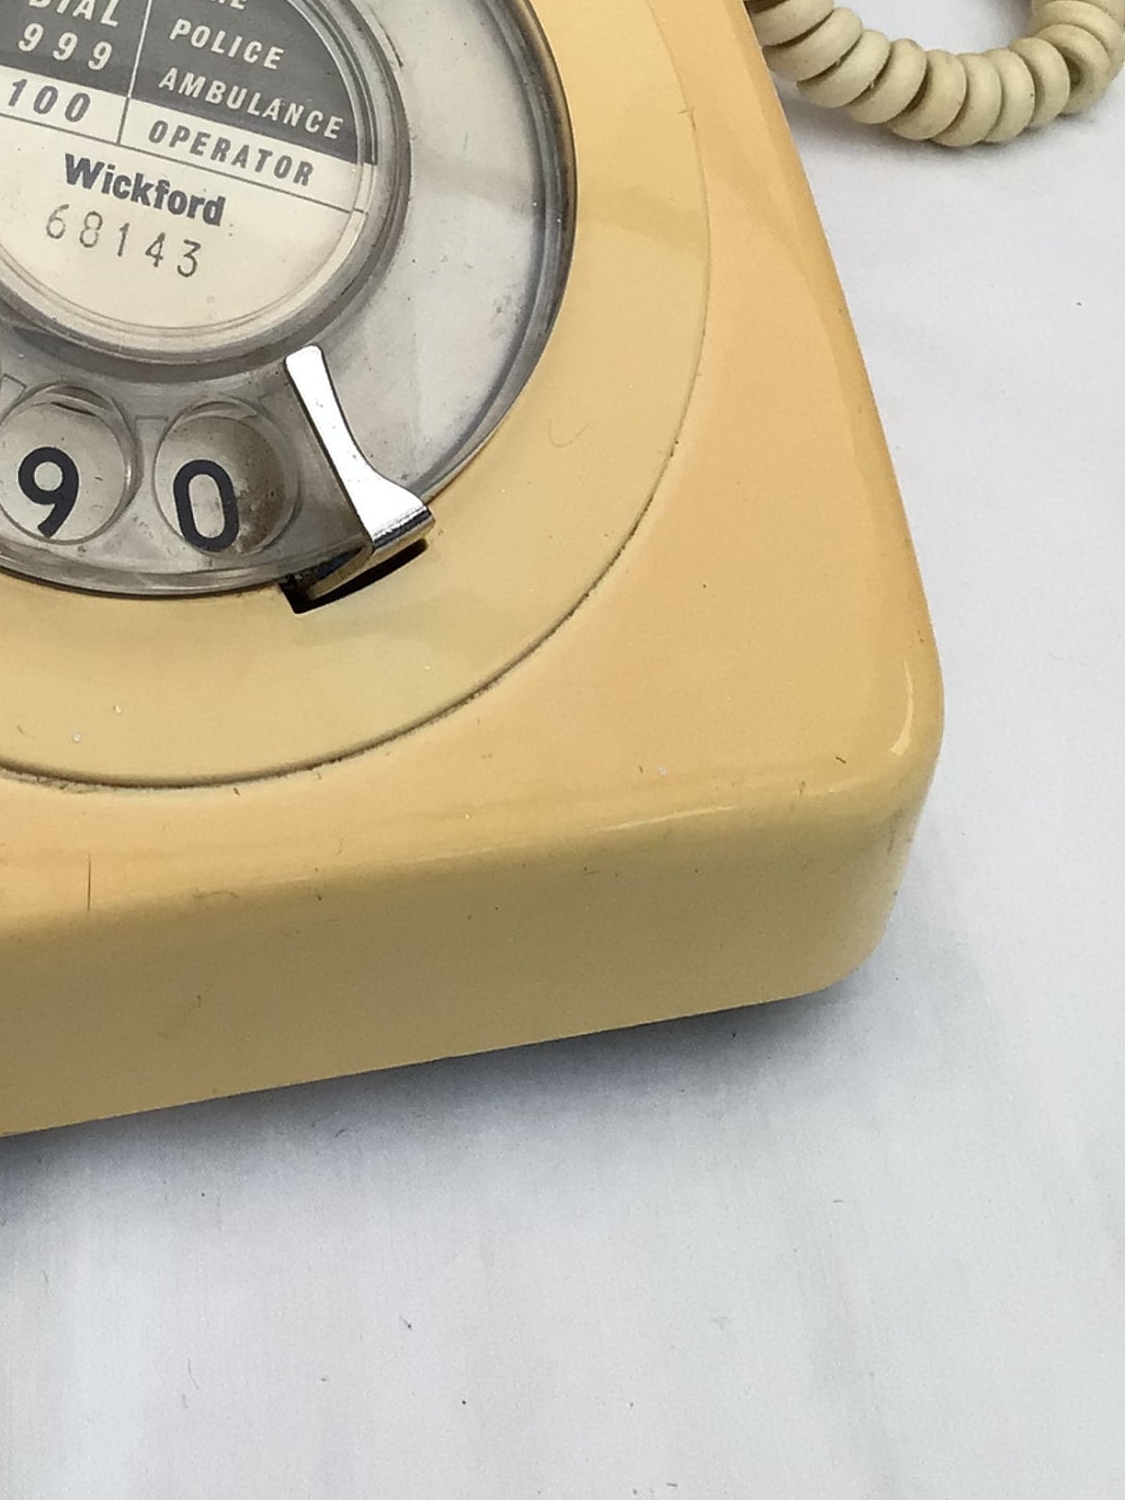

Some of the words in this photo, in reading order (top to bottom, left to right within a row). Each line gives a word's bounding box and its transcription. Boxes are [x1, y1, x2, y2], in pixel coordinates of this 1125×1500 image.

[18, 23, 113, 71] 999
[169, 18, 285, 70] POLICE
[9, 78, 92, 123] 100
[158, 67, 344, 139] AMBULANCE
[148, 119, 314, 186] OPERATOR
[65, 153, 227, 227] Wickford
[46, 204, 202, 277] 68143
[18, 446, 78, 539] 9
[172, 459, 240, 552] 0
